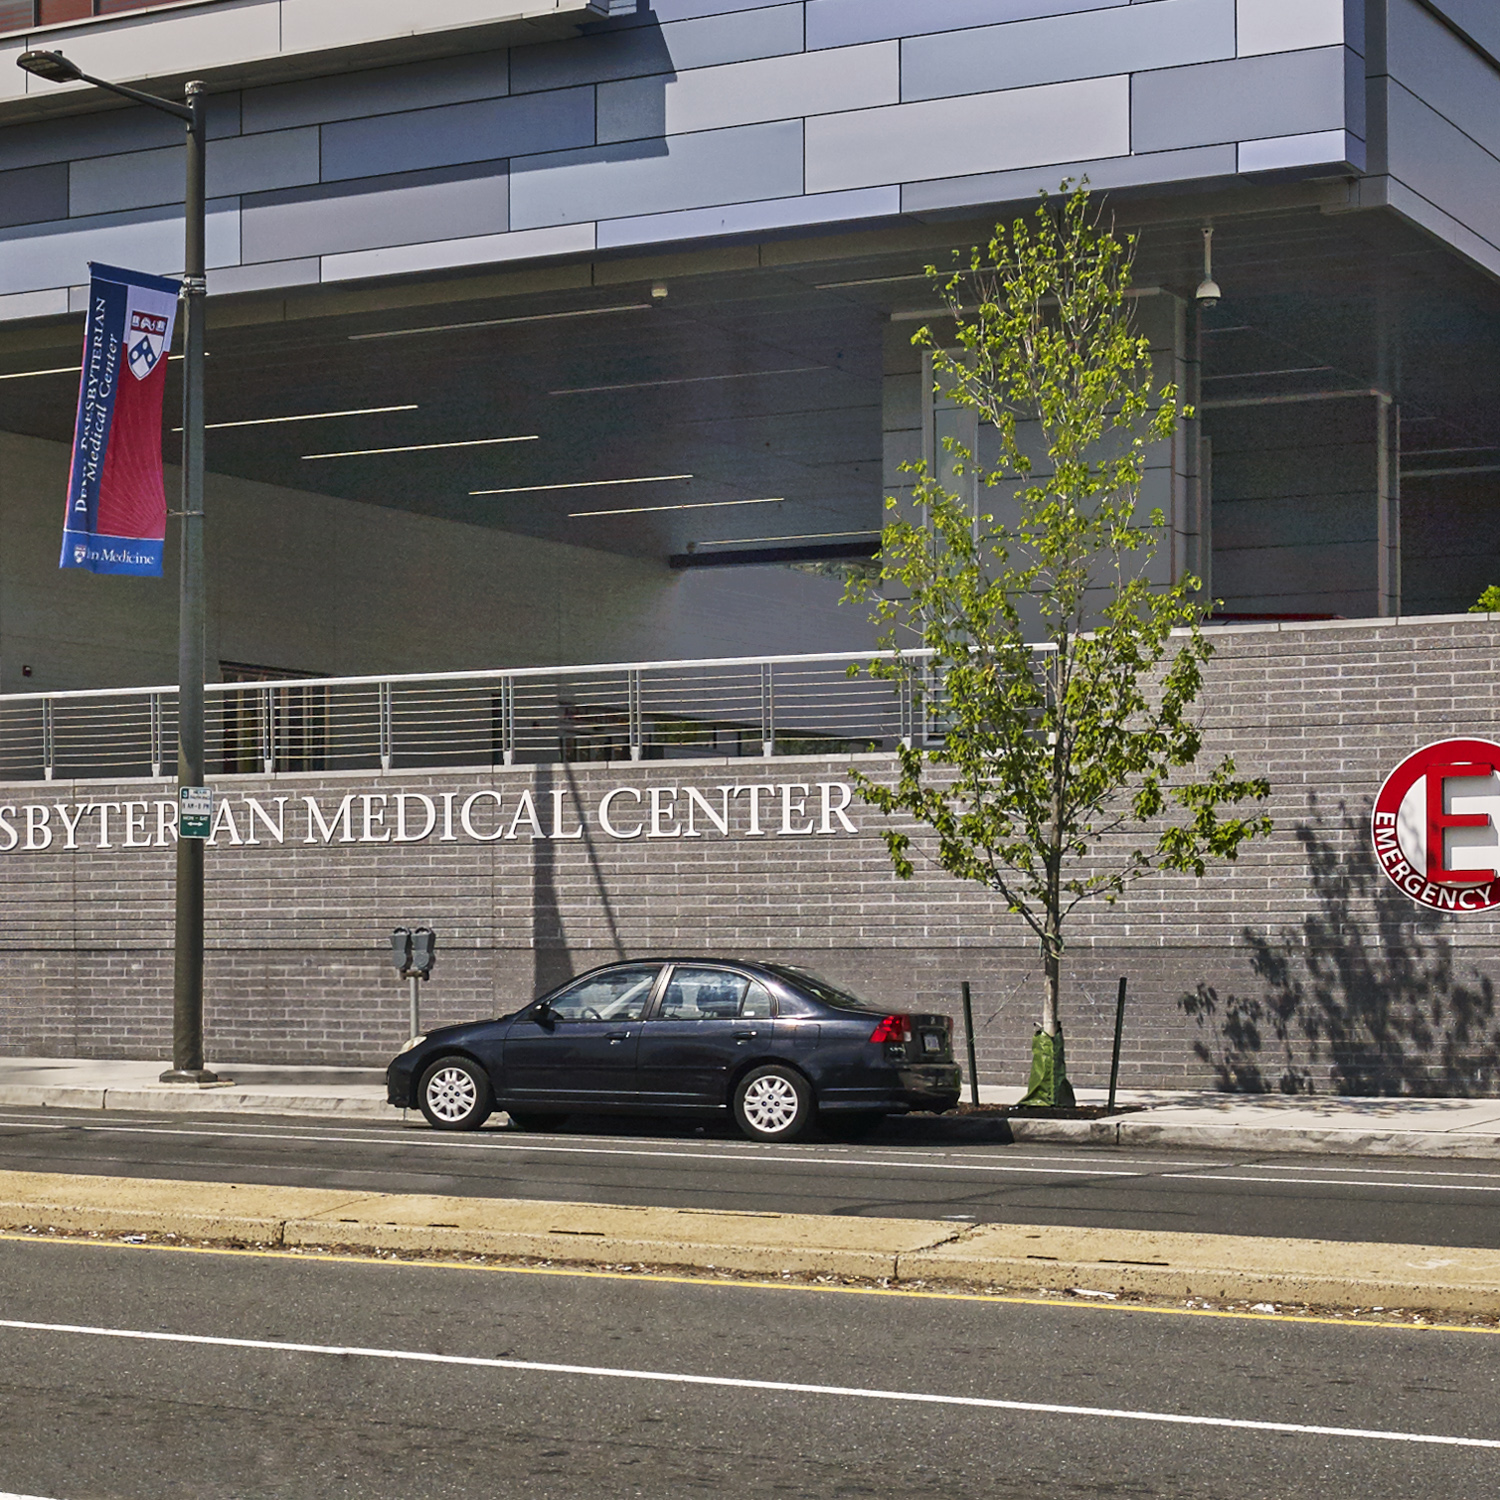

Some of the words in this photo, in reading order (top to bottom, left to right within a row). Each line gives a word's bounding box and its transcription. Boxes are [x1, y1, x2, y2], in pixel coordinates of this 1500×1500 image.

[87, 403, 107, 481] Medical
[99, 333, 118, 398] Center
[101, 548, 155, 565] Medicine
[303, 789, 583, 844] MEDICAL
[599, 782, 859, 840] CENTER
[1375, 811, 1492, 909] EMERGENCY
[1425, 763, 1496, 882] E
